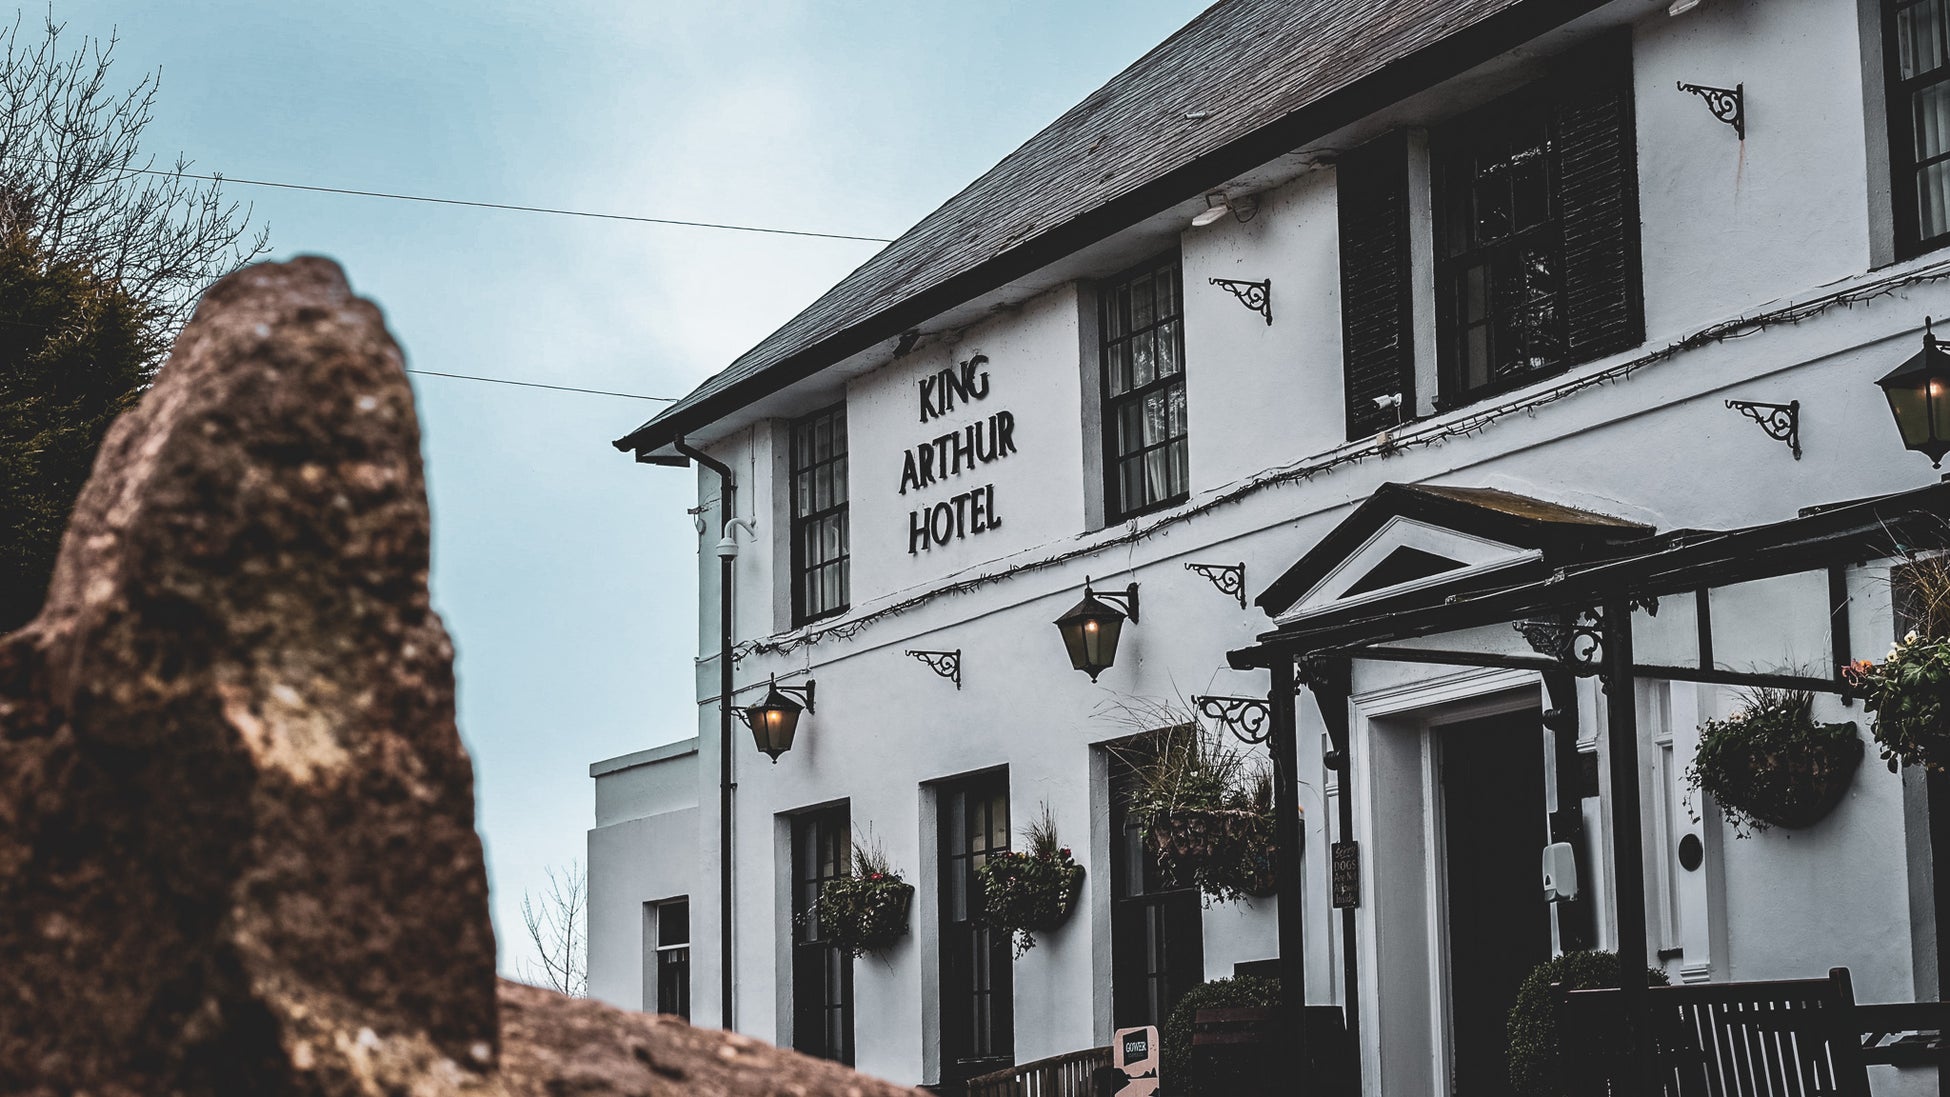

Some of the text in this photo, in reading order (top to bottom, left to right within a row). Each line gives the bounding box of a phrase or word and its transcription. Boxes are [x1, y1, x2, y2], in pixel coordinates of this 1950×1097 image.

[918, 355, 990, 423] KING
[899, 411, 1017, 495] ARTHUR
[908, 484, 1001, 556] HOTEL
[1334, 859, 1357, 872] DOGS
